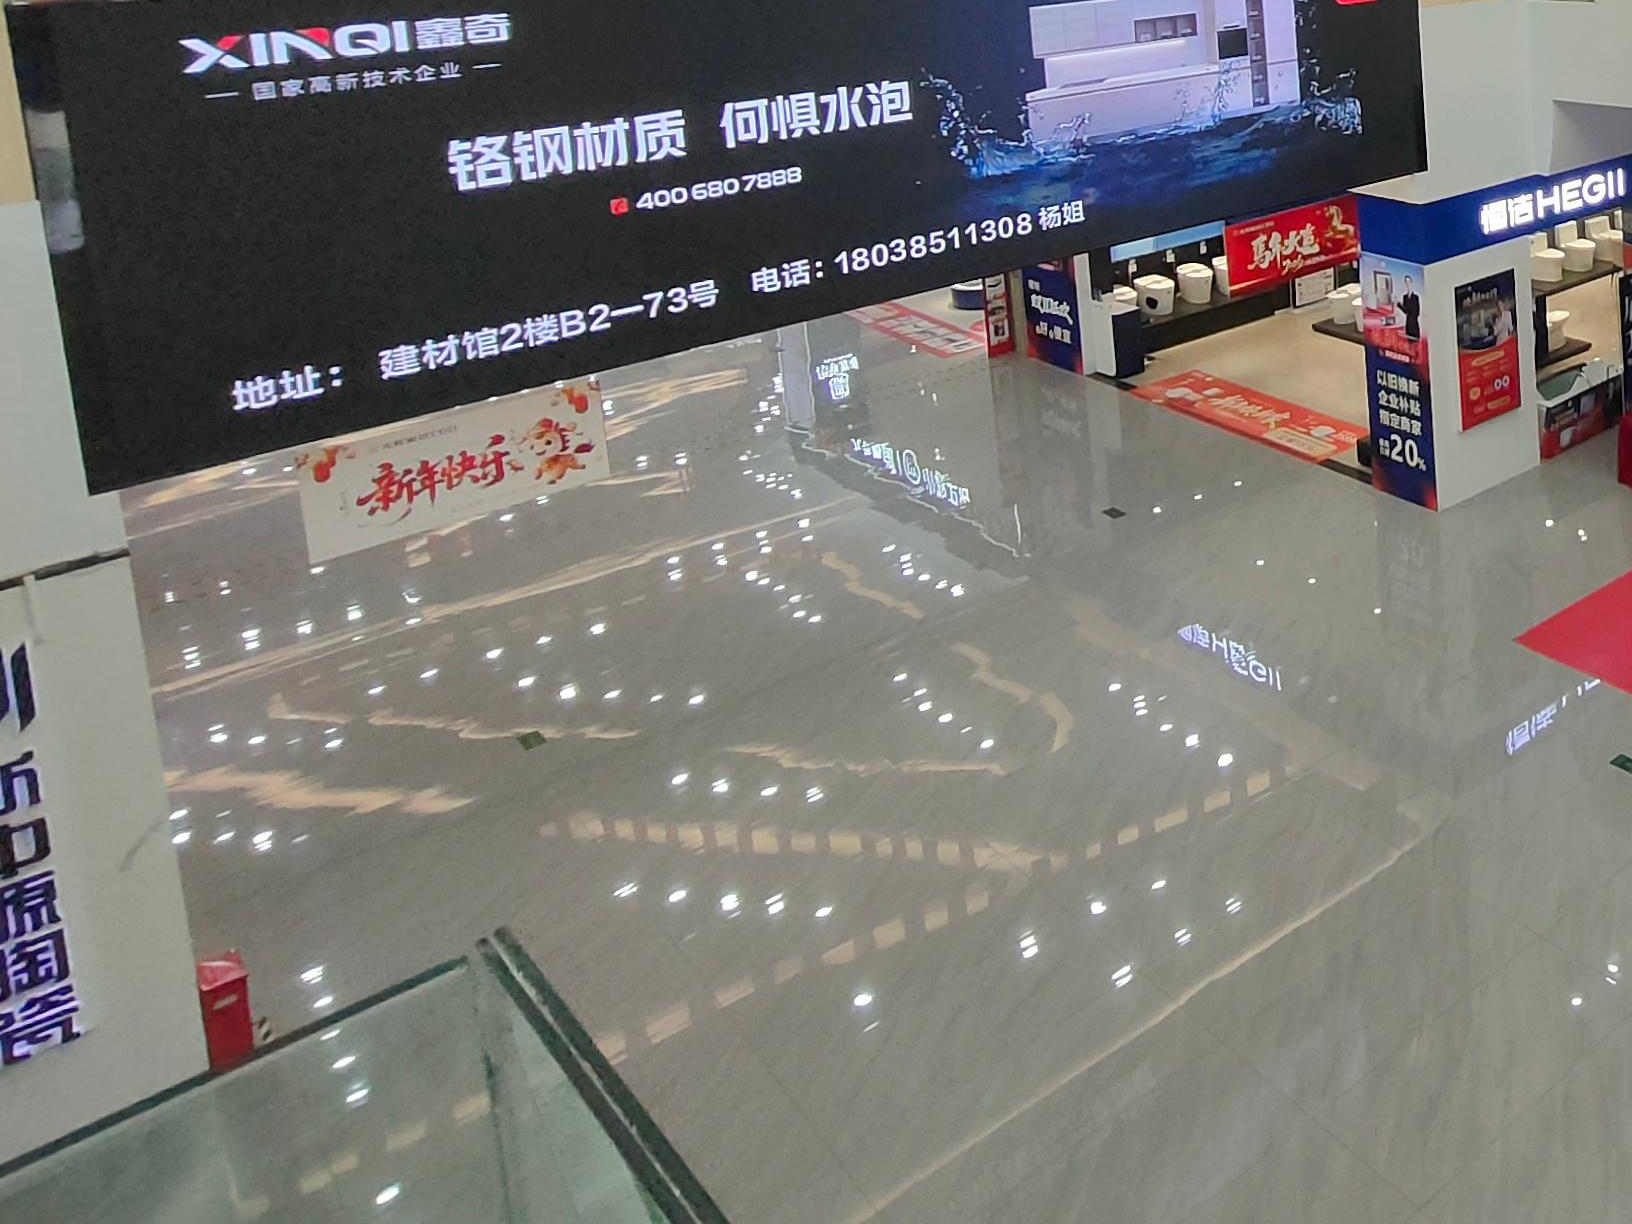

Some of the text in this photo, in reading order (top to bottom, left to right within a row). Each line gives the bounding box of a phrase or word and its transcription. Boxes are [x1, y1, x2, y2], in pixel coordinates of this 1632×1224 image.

[416, 12, 513, 51] 鑫奇
[251, 62, 462, 101] 国家高新技术企业
[447, 79, 913, 192] 铬钢材质 何惧水泡
[1038, 197, 1087, 230] 杨姐
[1390, 433, 1426, 473] 20%
[356, 434, 511, 520] 新年快乐
